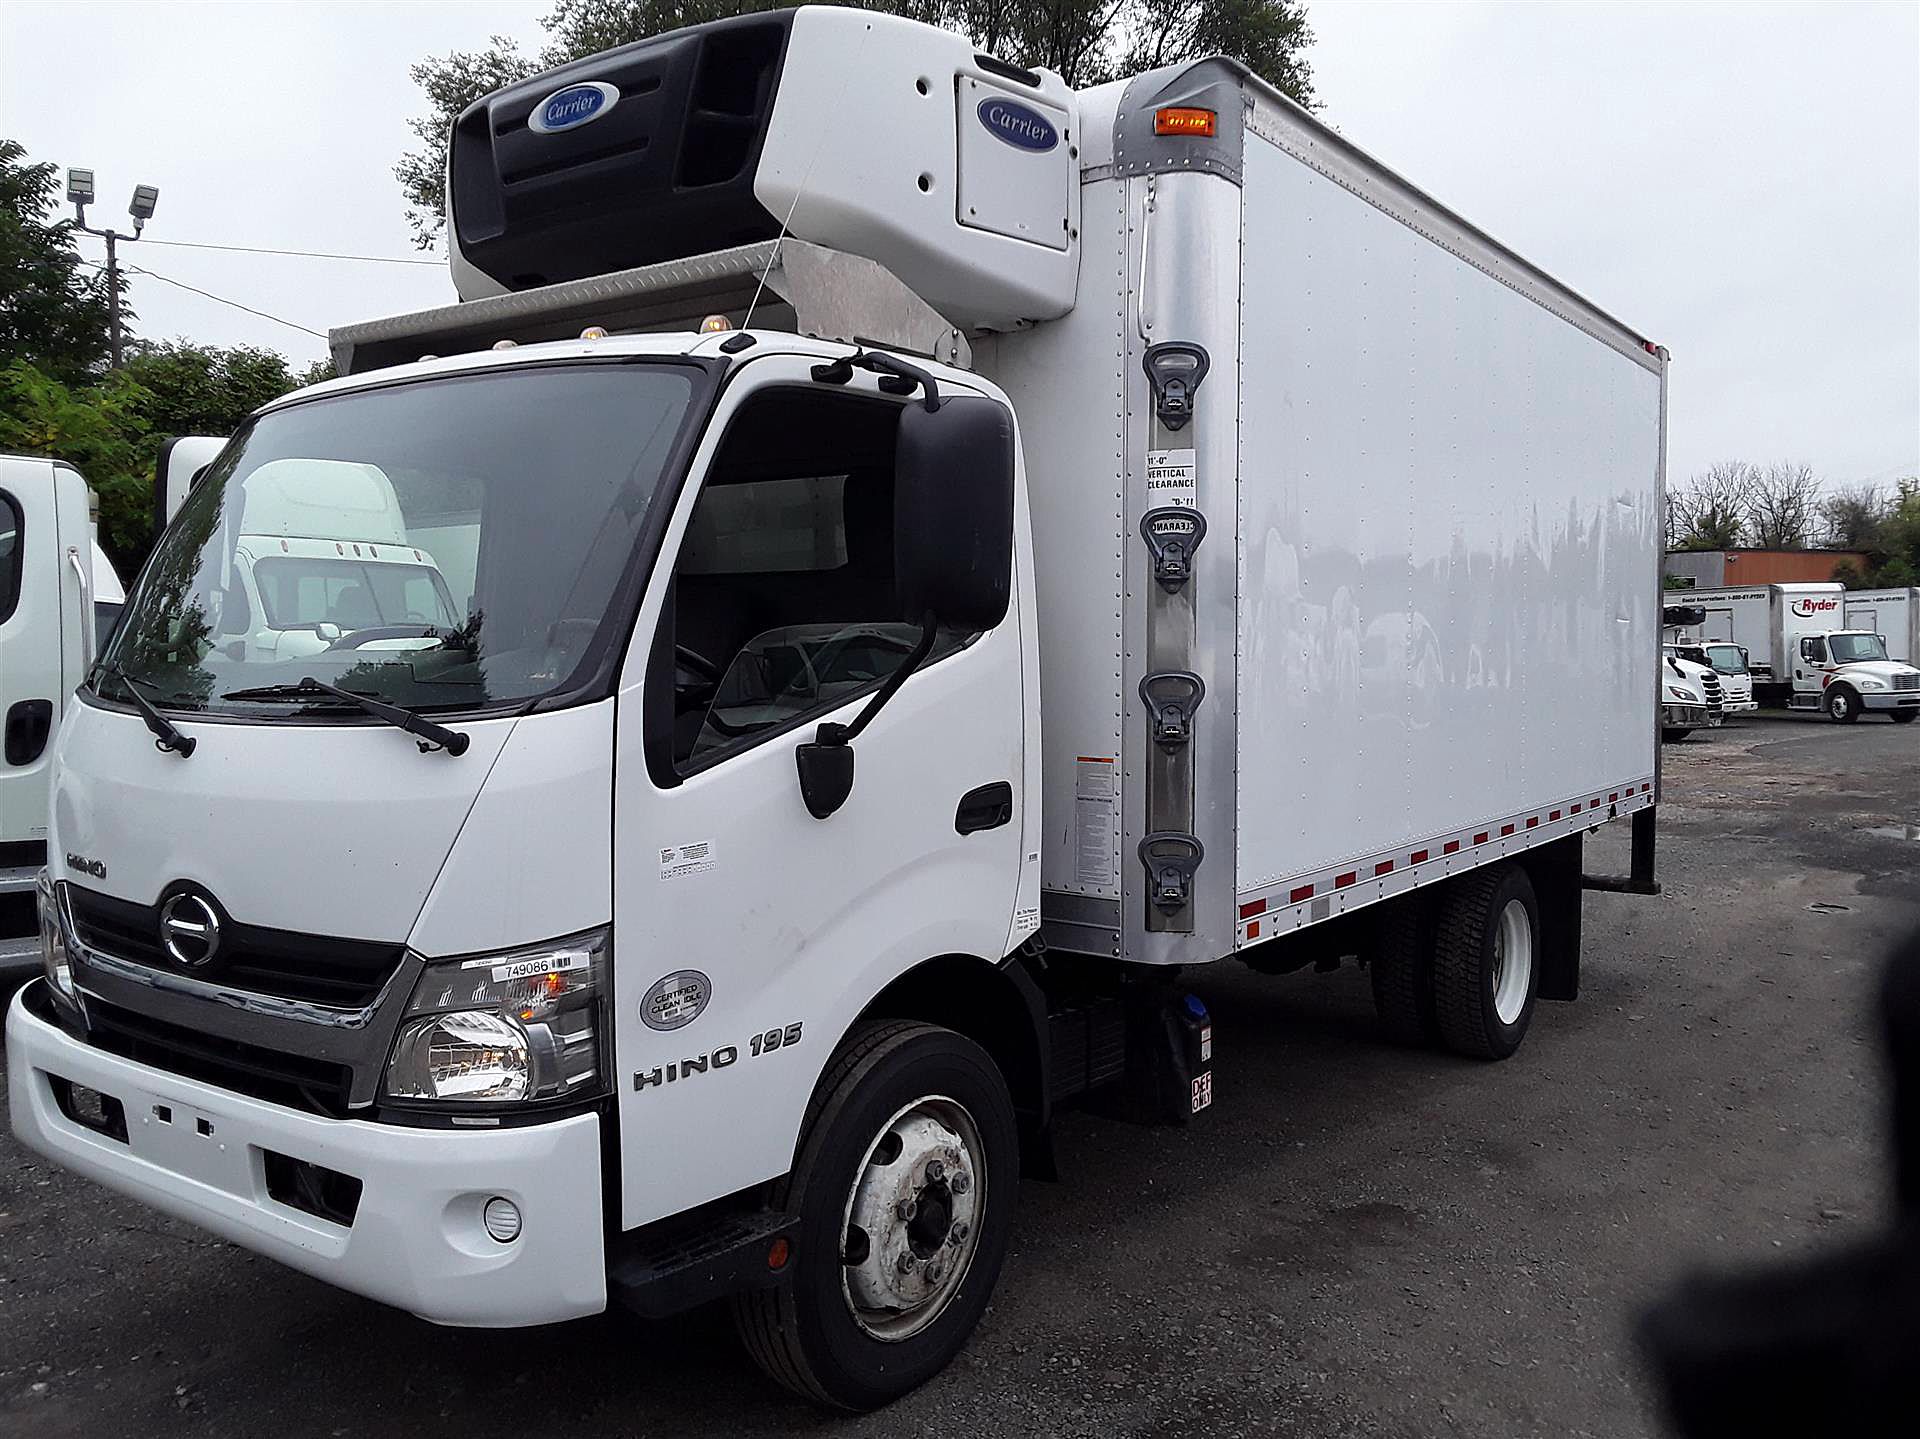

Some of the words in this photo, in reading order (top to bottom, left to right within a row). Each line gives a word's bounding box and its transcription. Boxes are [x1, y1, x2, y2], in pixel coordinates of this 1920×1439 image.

[547, 95, 596, 121] Carrier
[989, 105, 1048, 141] Carrier
[1147, 479, 1194, 489] CLEARANCE
[1802, 599, 1838, 613] Ryder
[505, 960, 549, 978] 749086
[655, 984, 698, 1004] CERTIFIED
[651, 1000, 680, 1014] CLEAN
[633, 1045, 738, 1092] HINO
[749, 1020, 803, 1058] 195
[1192, 1072, 1211, 1097] DEF
